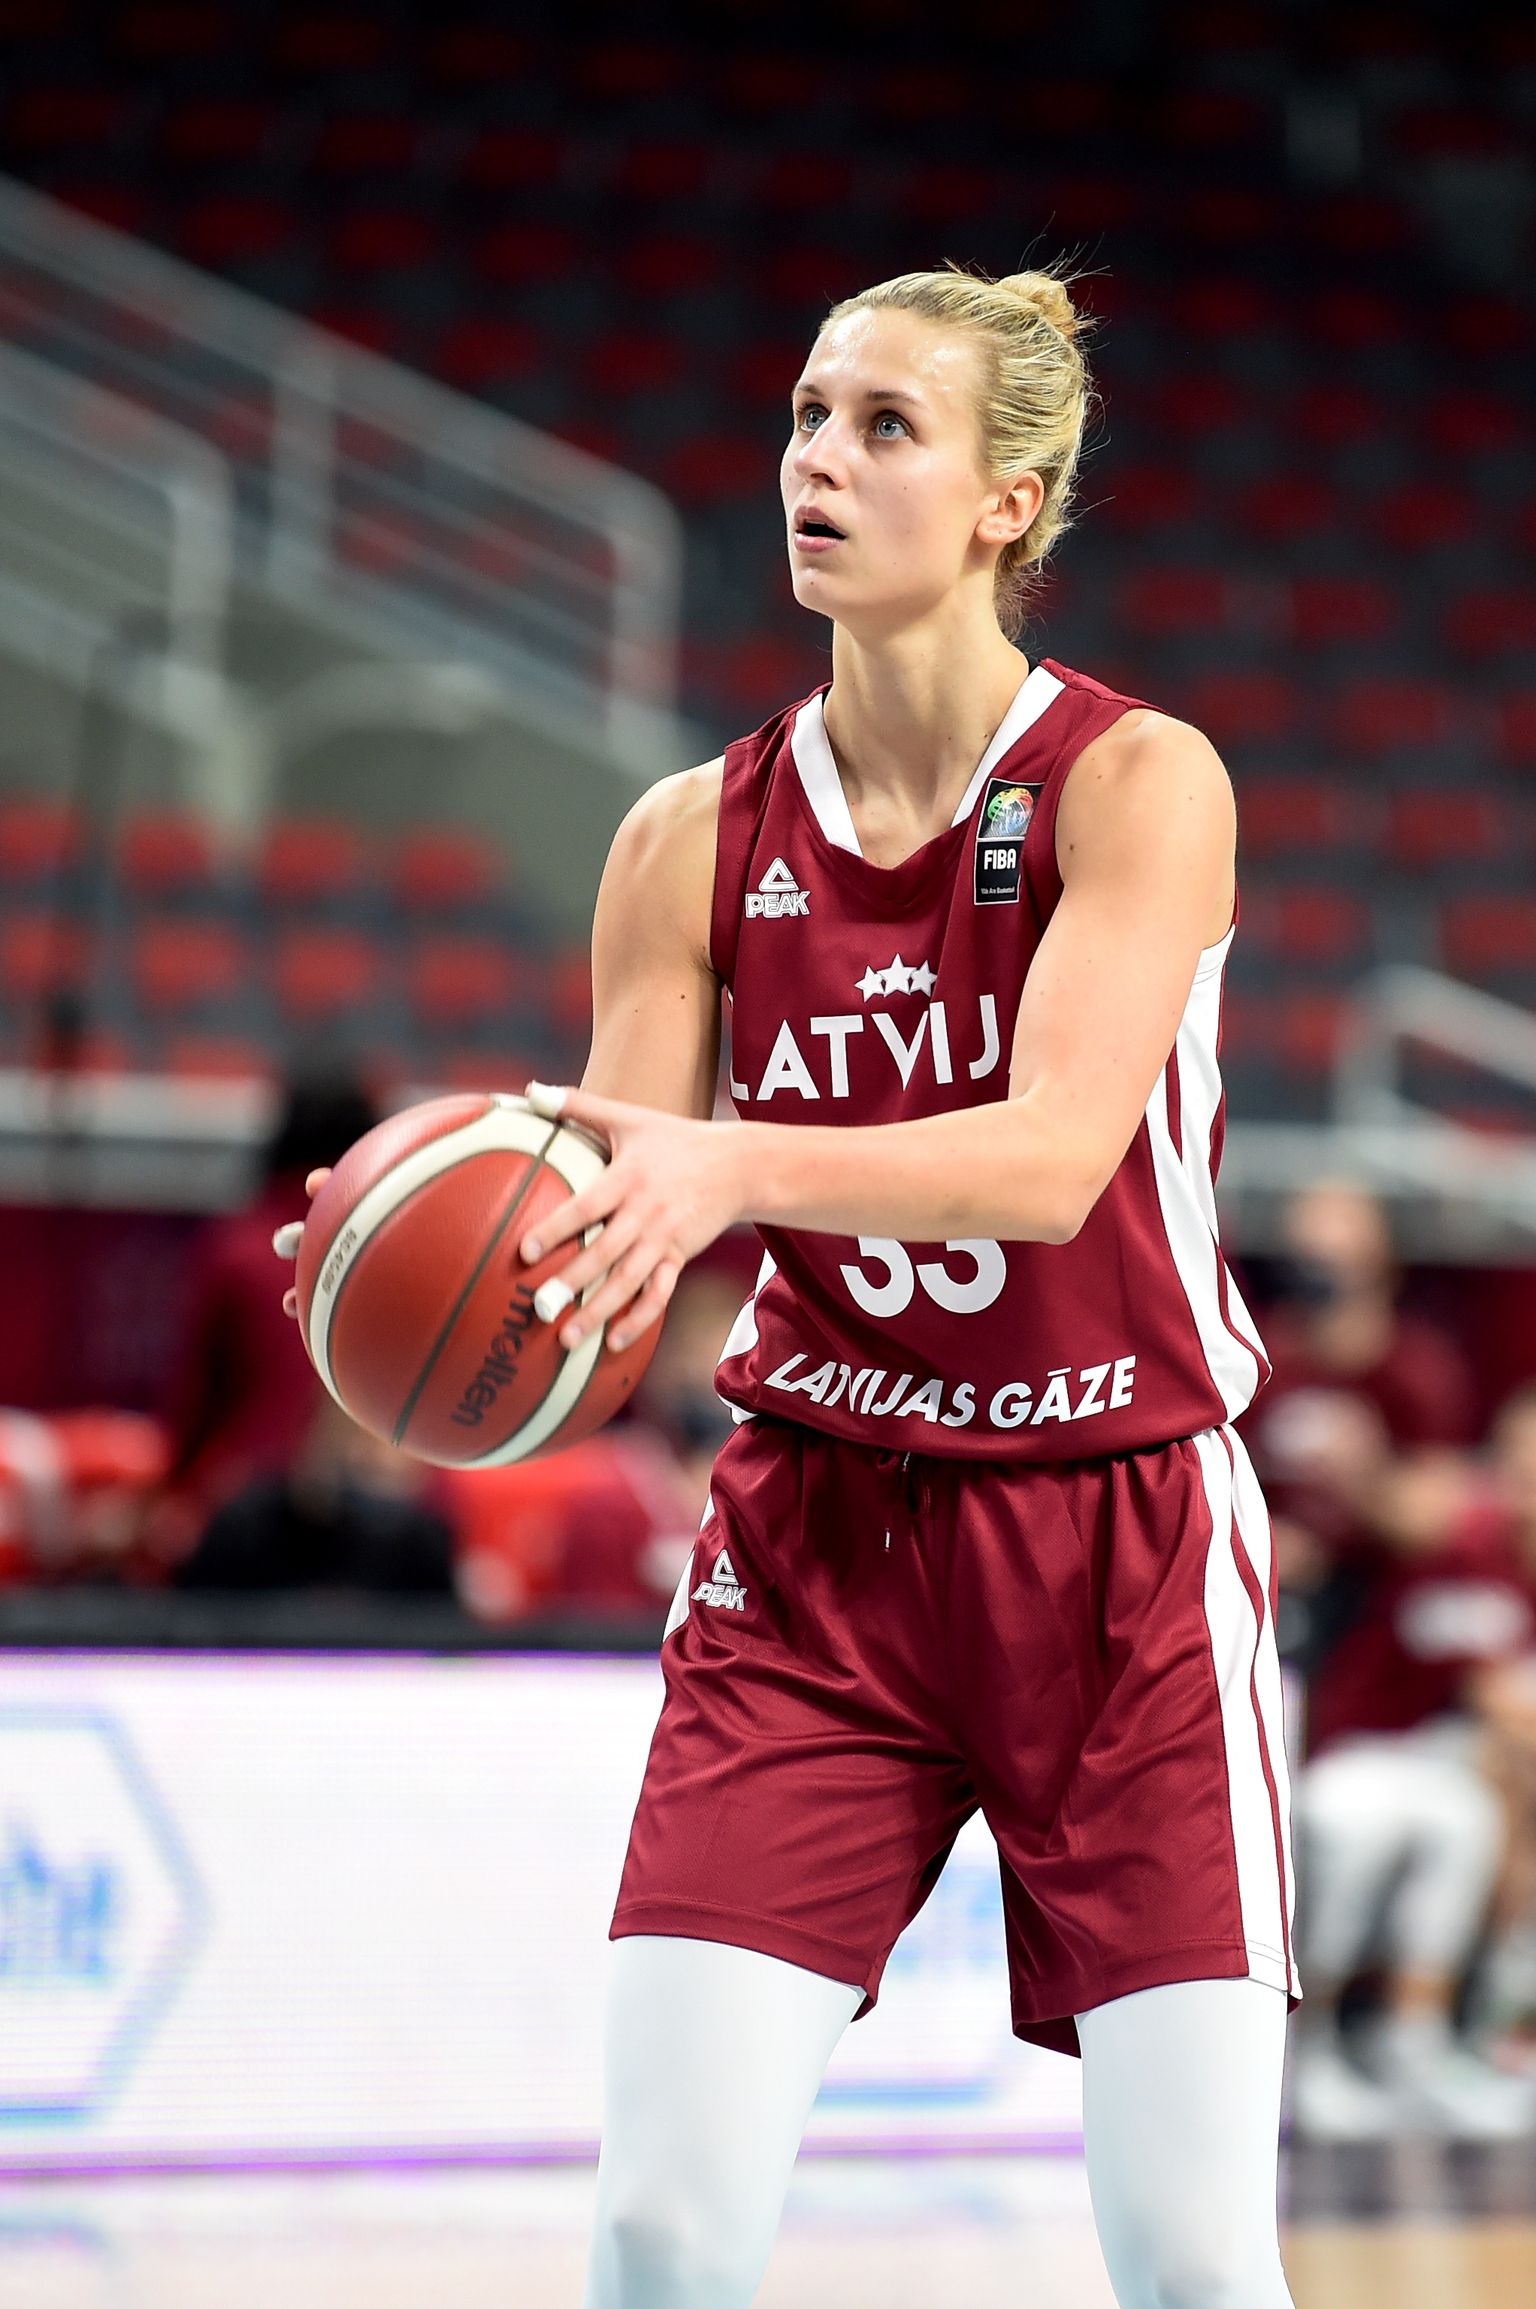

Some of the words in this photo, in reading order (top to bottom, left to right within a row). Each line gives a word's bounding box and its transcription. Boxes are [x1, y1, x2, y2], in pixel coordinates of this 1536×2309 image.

[984, 849, 1016, 870] FIBA
[745, 891, 811, 918] PEAK
[728, 993, 1010, 1101] LATVIJ
[451, 1282, 536, 1427] molten
[988, 1354, 1137, 1429] GĀZE
[690, 1581, 748, 1612] PEAK
